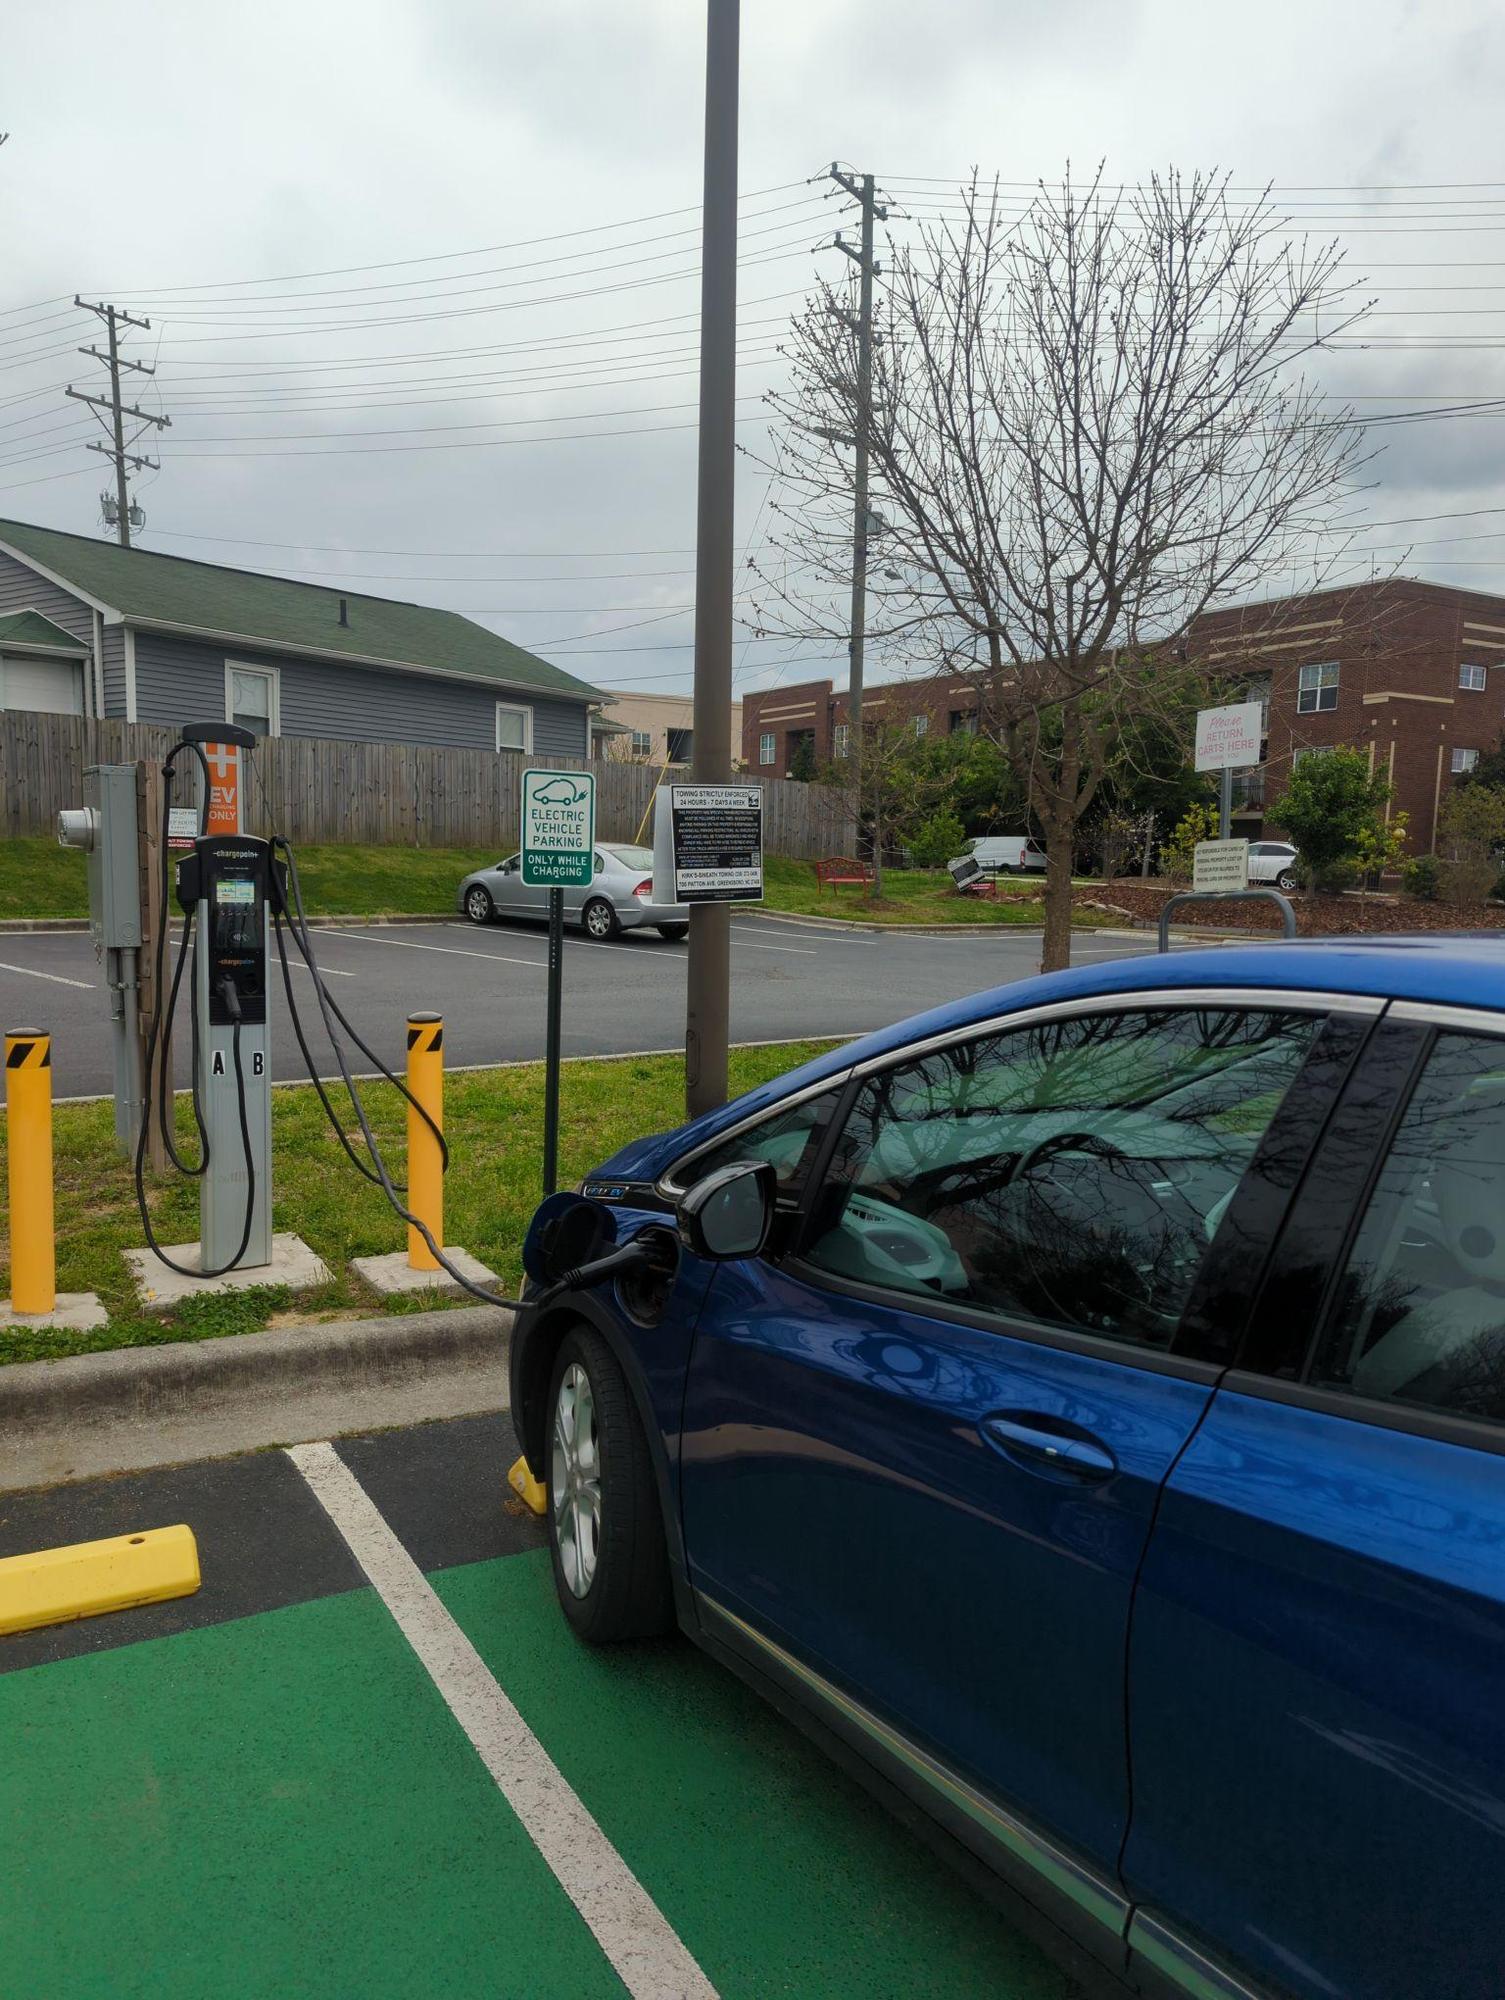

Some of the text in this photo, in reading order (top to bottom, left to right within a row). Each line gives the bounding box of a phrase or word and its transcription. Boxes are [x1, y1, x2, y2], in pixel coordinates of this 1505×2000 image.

[1207, 729, 1243, 741] RETURN
[1228, 739, 1254, 750] HERE
[210, 786, 236, 804] EV
[676, 790, 698, 798] TOWING
[700, 790, 723, 798] STRICTLY
[209, 810, 236, 820] ONLY
[531, 808, 585, 822] ELECTRIC
[534, 822, 582, 835] VEHICLE
[532, 835, 583, 848] PARKING
[528, 855, 587, 866] ONLY WHILE
[532, 865, 582, 877] CHARGING
[213, 1051, 225, 1075] A
[253, 1052, 264, 1075] B
